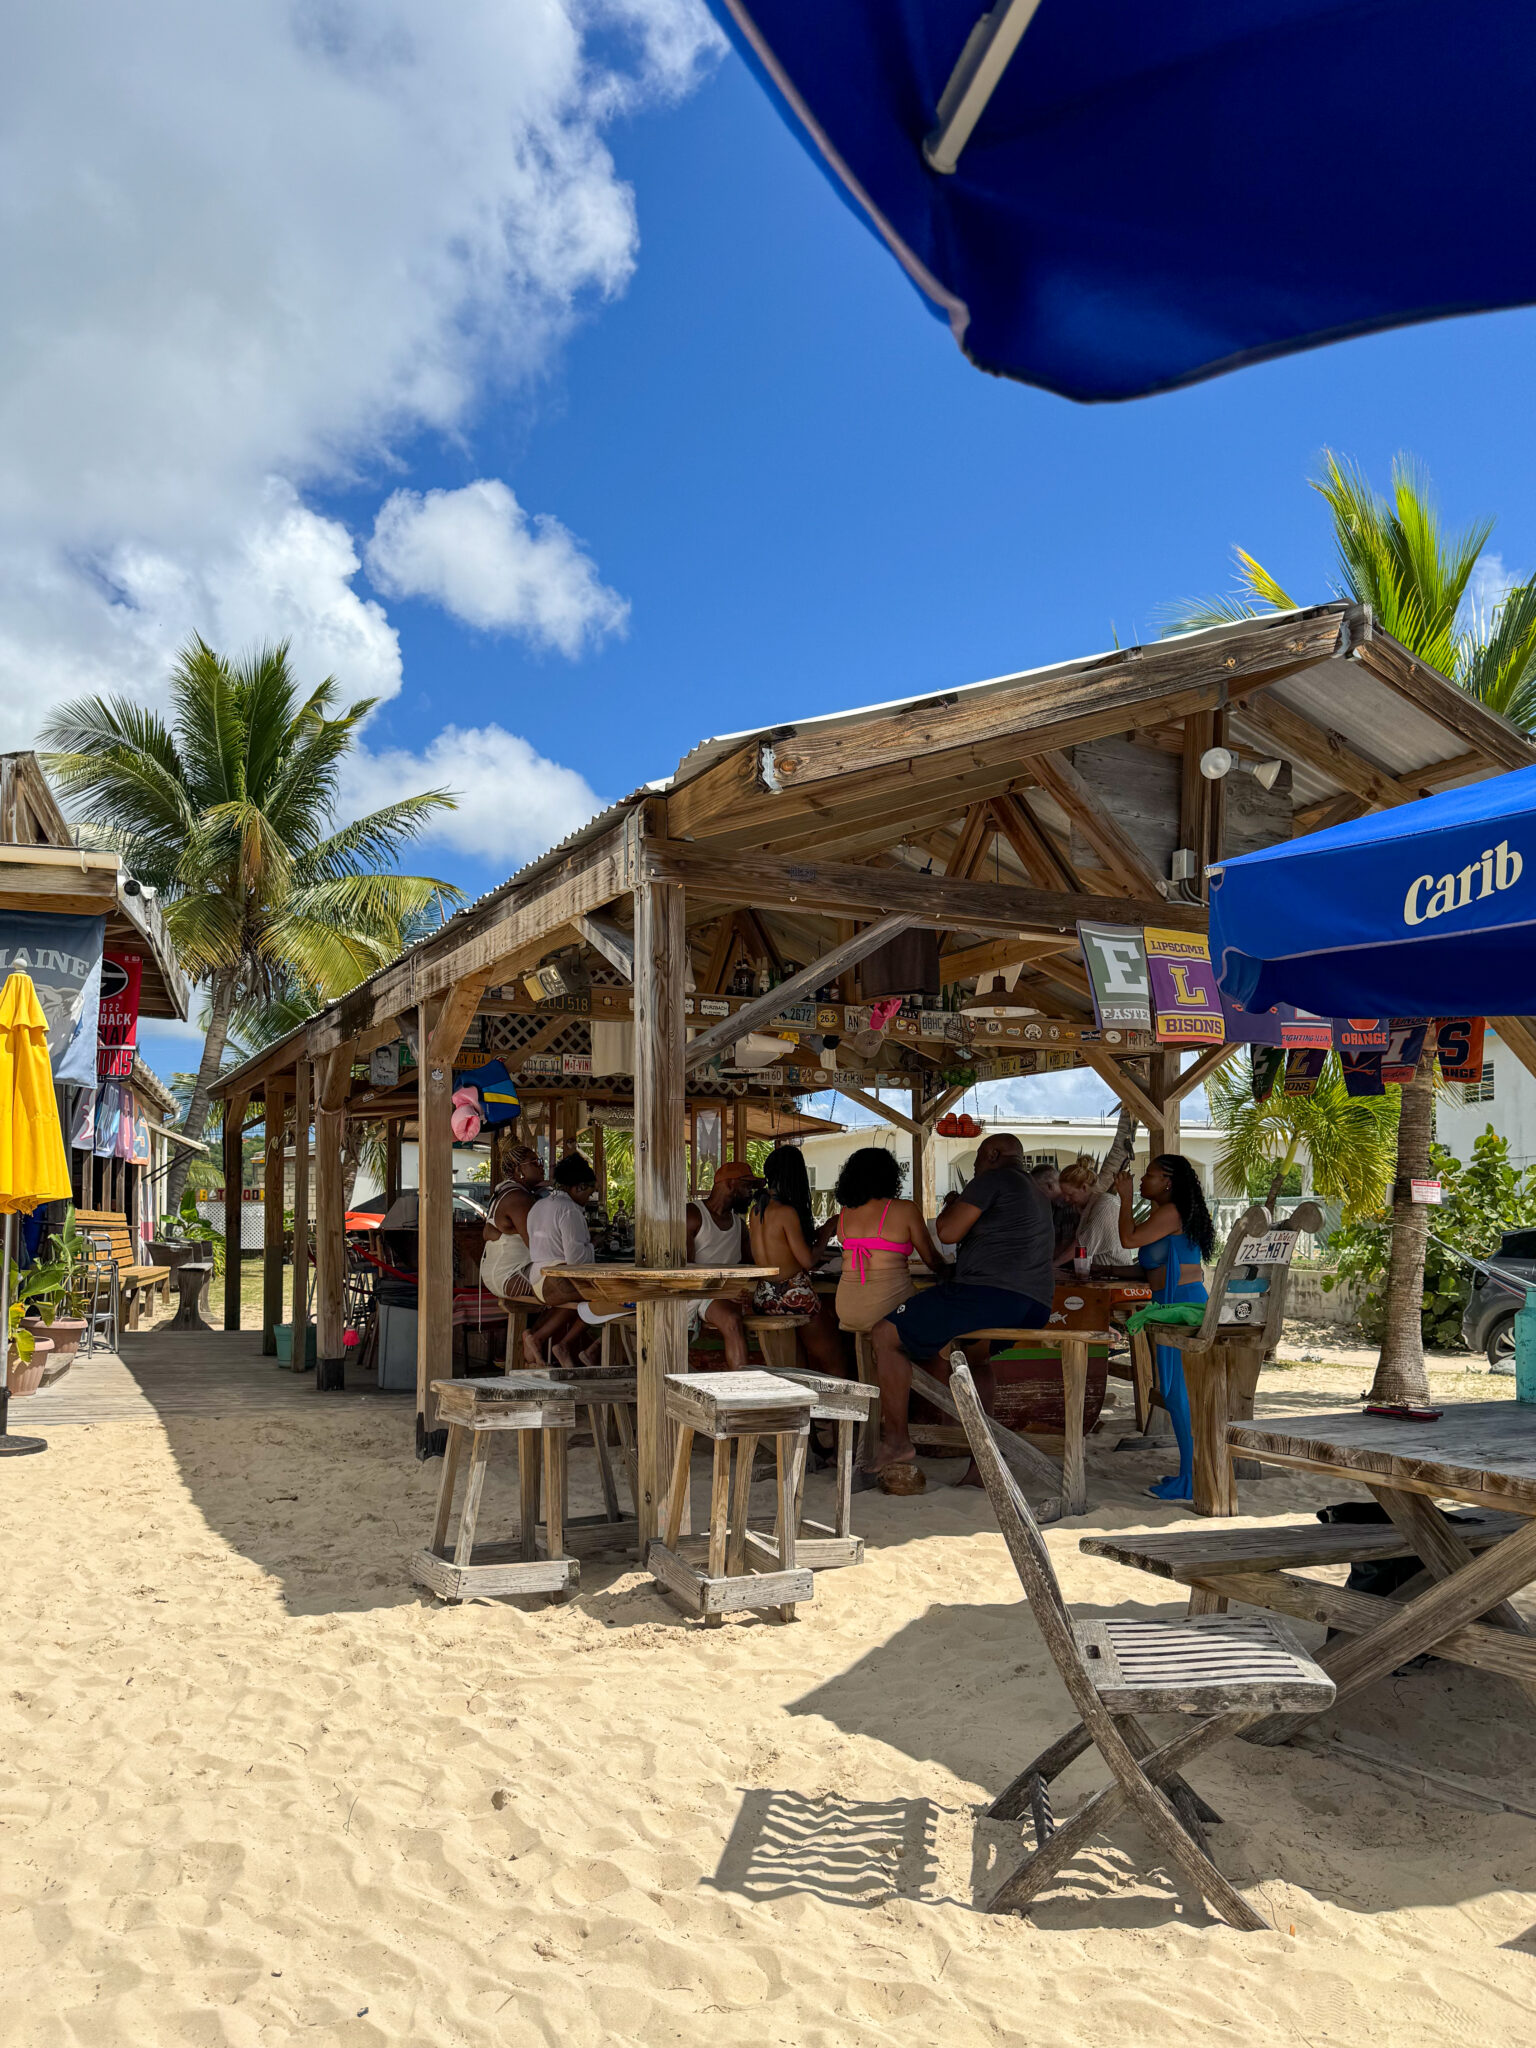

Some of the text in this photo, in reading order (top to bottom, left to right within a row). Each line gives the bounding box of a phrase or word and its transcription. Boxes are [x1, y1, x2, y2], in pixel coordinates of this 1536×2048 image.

[1404, 840, 1523, 926] Carib
[1150, 940, 1205, 955] LIPSCOMB
[1091, 937, 1149, 995] E
[1167, 963, 1209, 1006] L
[567, 996, 588, 1012] 518
[820, 1014, 836, 1023] 26.2
[1165, 1018, 1223, 1035] BISONS
[1341, 1032, 1387, 1045] ORANGE
[1437, 1020, 1471, 1068] S
